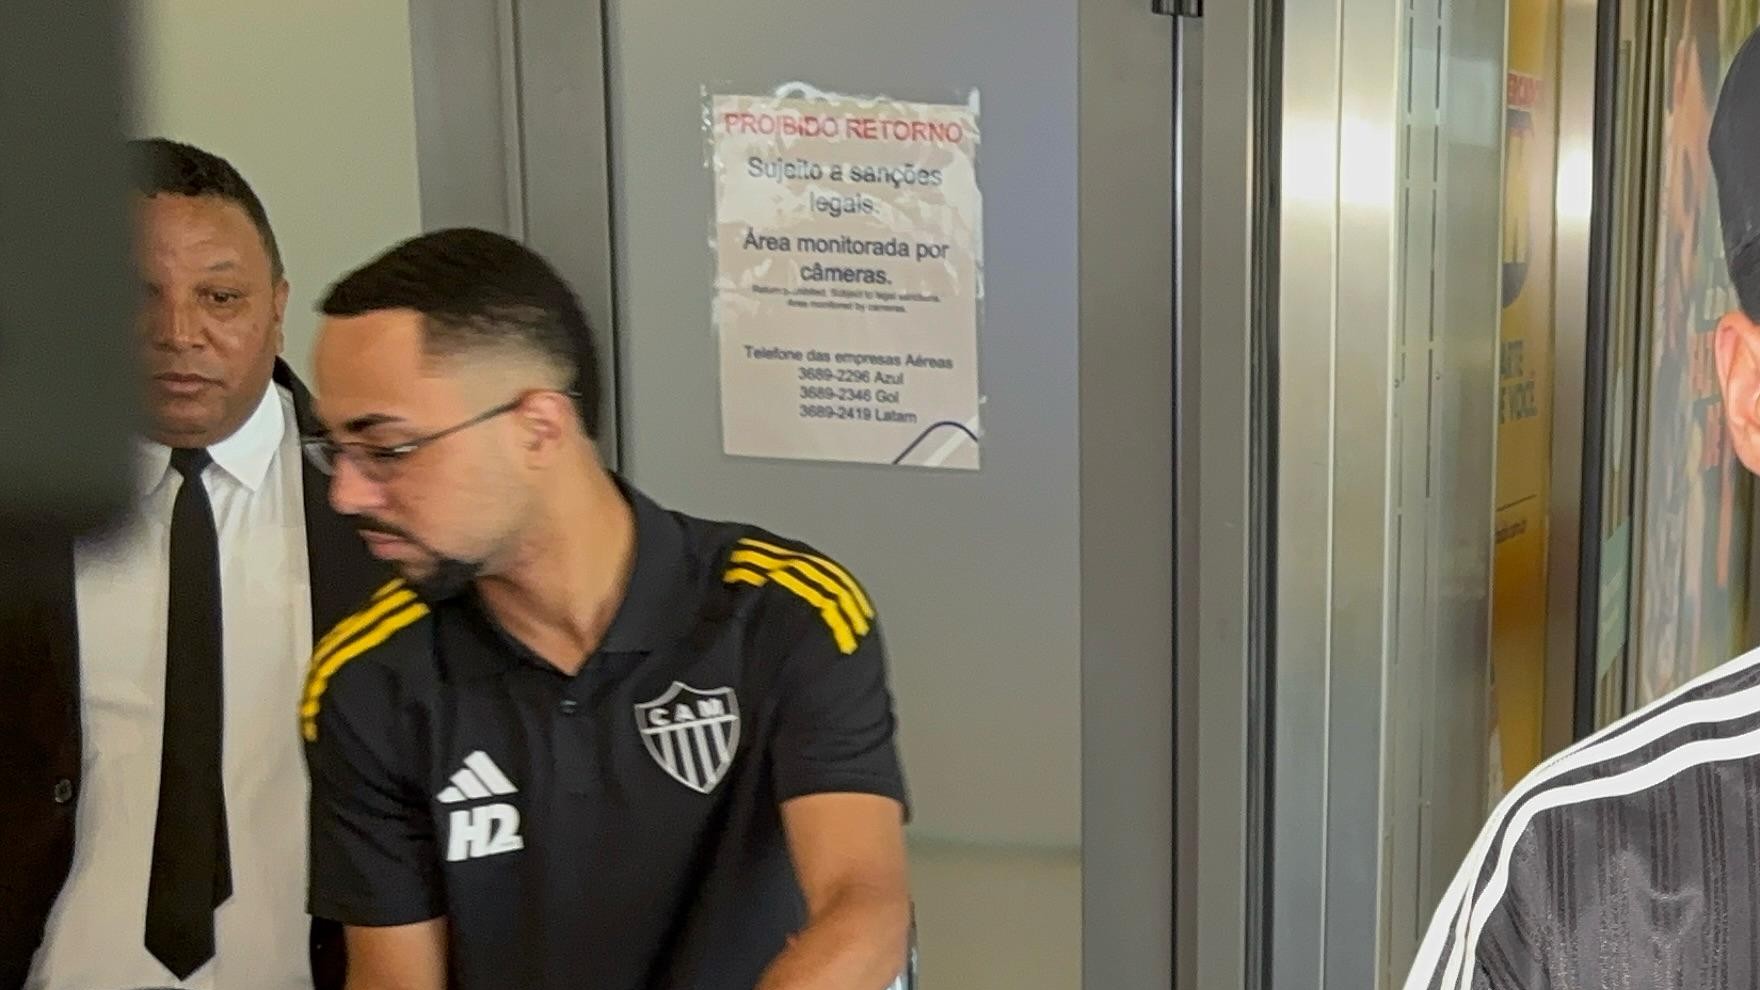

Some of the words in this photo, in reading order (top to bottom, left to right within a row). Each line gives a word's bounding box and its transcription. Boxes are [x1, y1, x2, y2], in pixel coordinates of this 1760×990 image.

[724, 112, 838, 139] PROIBIDO
[845, 118, 963, 143] RETORNO
[747, 156, 823, 184] Sujeito
[830, 166, 843, 180] a
[850, 161, 943, 189] sanções
[743, 226, 791, 252] Área
[796, 233, 909, 258] monitorada
[915, 242, 950, 262] por
[800, 262, 892, 285] câmeras.
[743, 345, 803, 362] Telefone
[807, 349, 831, 363] das
[834, 352, 901, 367] empresas
[905, 352, 953, 370] Aéreas
[874, 370, 904, 385] Azul
[875, 389, 900, 404] Gol
[875, 408, 917, 424] Latam
[648, 698, 725, 726] CAM
[447, 802, 524, 862] H2
